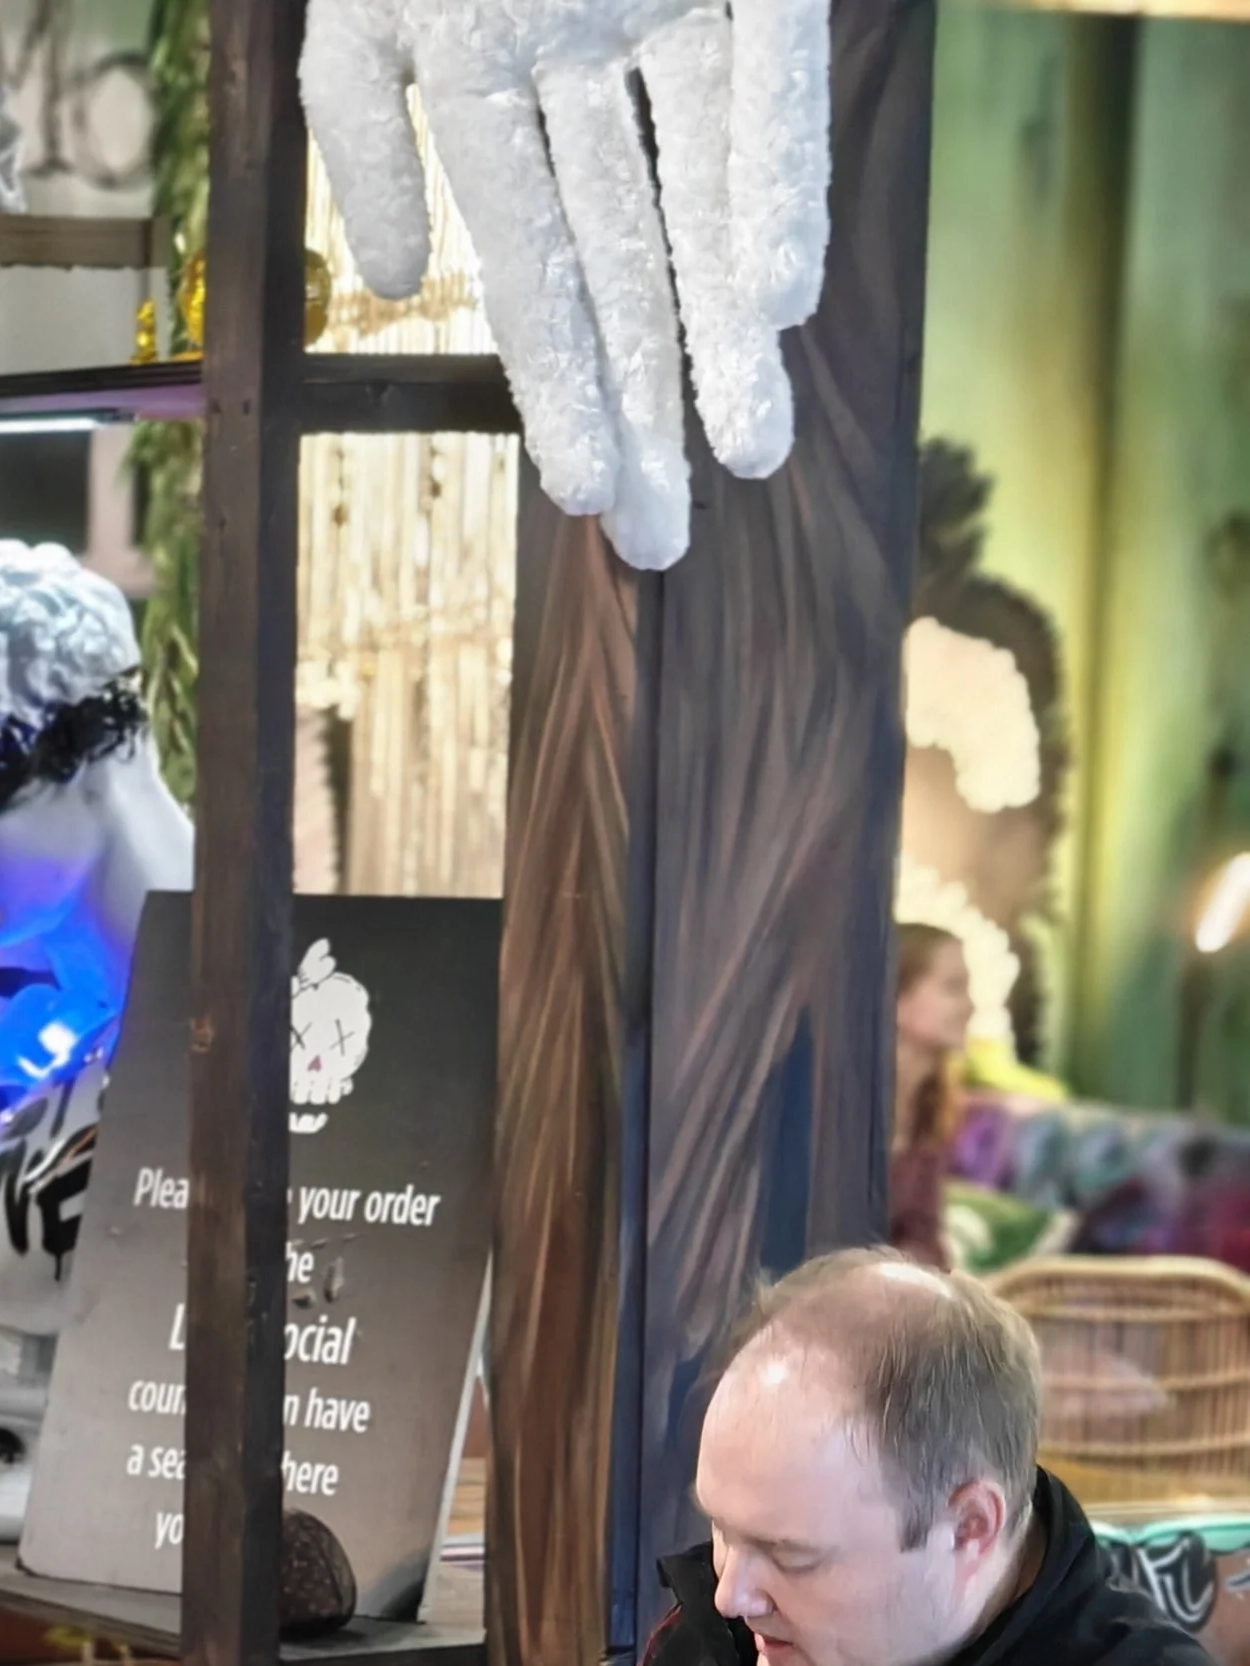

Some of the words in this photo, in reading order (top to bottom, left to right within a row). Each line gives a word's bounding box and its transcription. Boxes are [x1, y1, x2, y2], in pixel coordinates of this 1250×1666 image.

[133, 1167, 190, 1210] Plea
[297, 1186, 360, 1224] your
[364, 1184, 441, 1226] order
[285, 1242, 314, 1283] he
[284, 1314, 357, 1366] ocial
[128, 1380, 186, 1416] coun
[304, 1387, 370, 1433] have
[126, 1444, 144, 1476] a
[155, 1511, 184, 1550] yo
